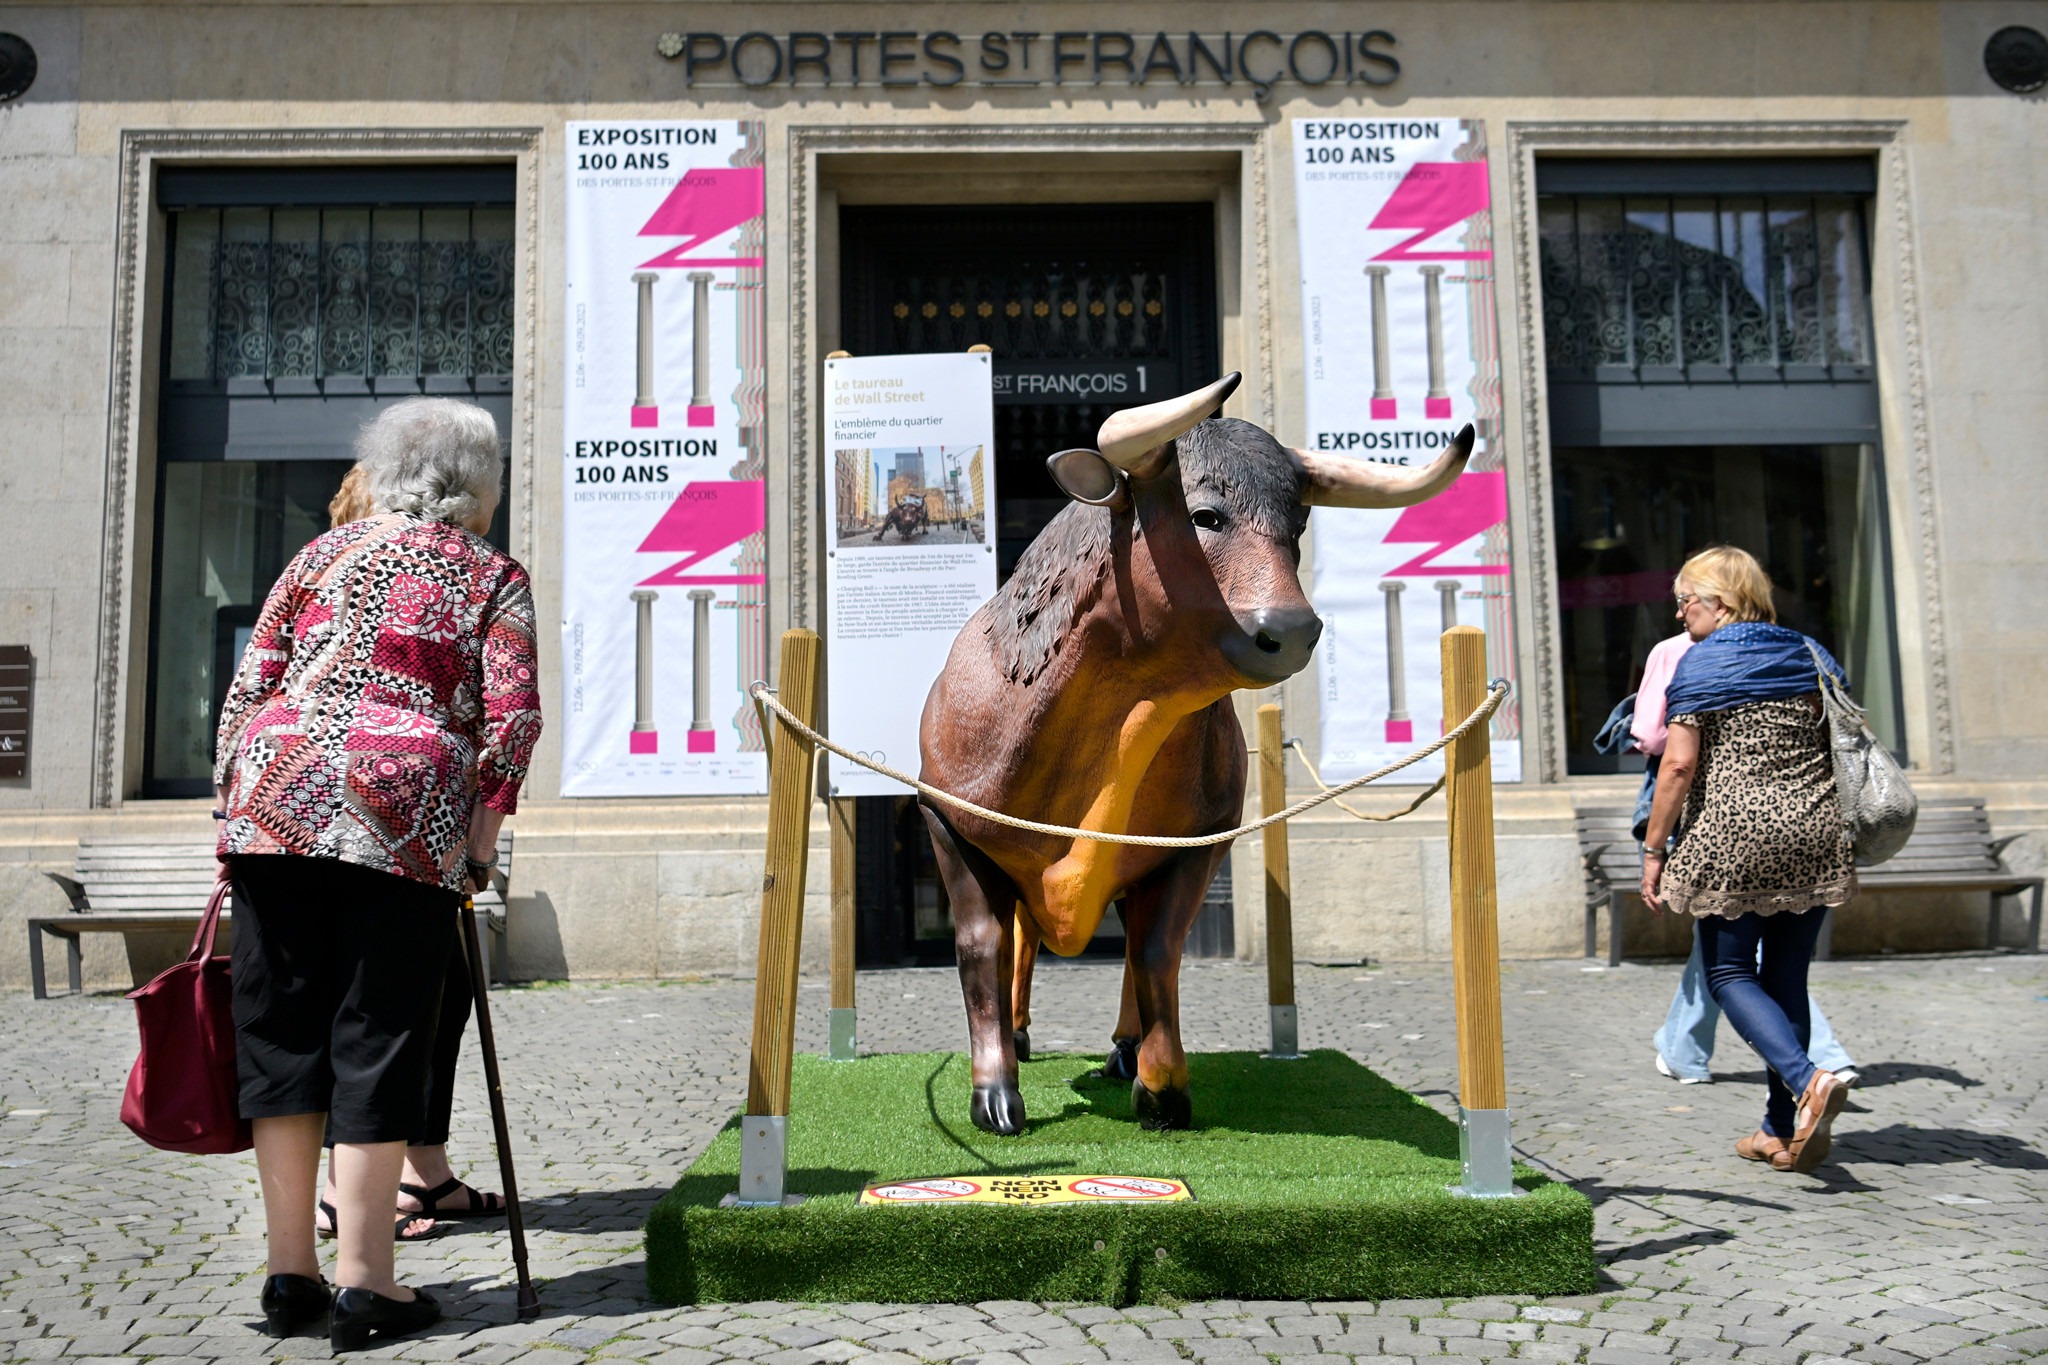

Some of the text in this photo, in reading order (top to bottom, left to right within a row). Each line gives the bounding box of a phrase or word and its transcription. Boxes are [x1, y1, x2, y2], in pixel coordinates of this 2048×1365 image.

[686, 31, 965, 87] PORTES
[1053, 30, 1400, 100] FRANÇOIS
[578, 128, 717, 146] EXPOSITION
[1304, 123, 1439, 140] EXPOSITION
[578, 152, 670, 170] 100 ANS
[1305, 148, 1395, 164] 100 ANS
[577, 178, 598, 188] DES
[1305, 172, 1326, 181] DES
[835, 378, 903, 391] Le taureau
[1017, 373, 1127, 399] FRANÇOIS
[1136, 366, 1147, 393] 1
[835, 392, 925, 406] de Wall Street
[889, 417, 901, 427] du
[904, 416, 943, 428] quartier
[835, 430, 877, 441] financier
[1318, 431, 1455, 450] EXPOSITION
[575, 440, 717, 458] EXPOSITION
[575, 465, 669, 484] 100 ANS
[574, 492, 597, 502] DES
